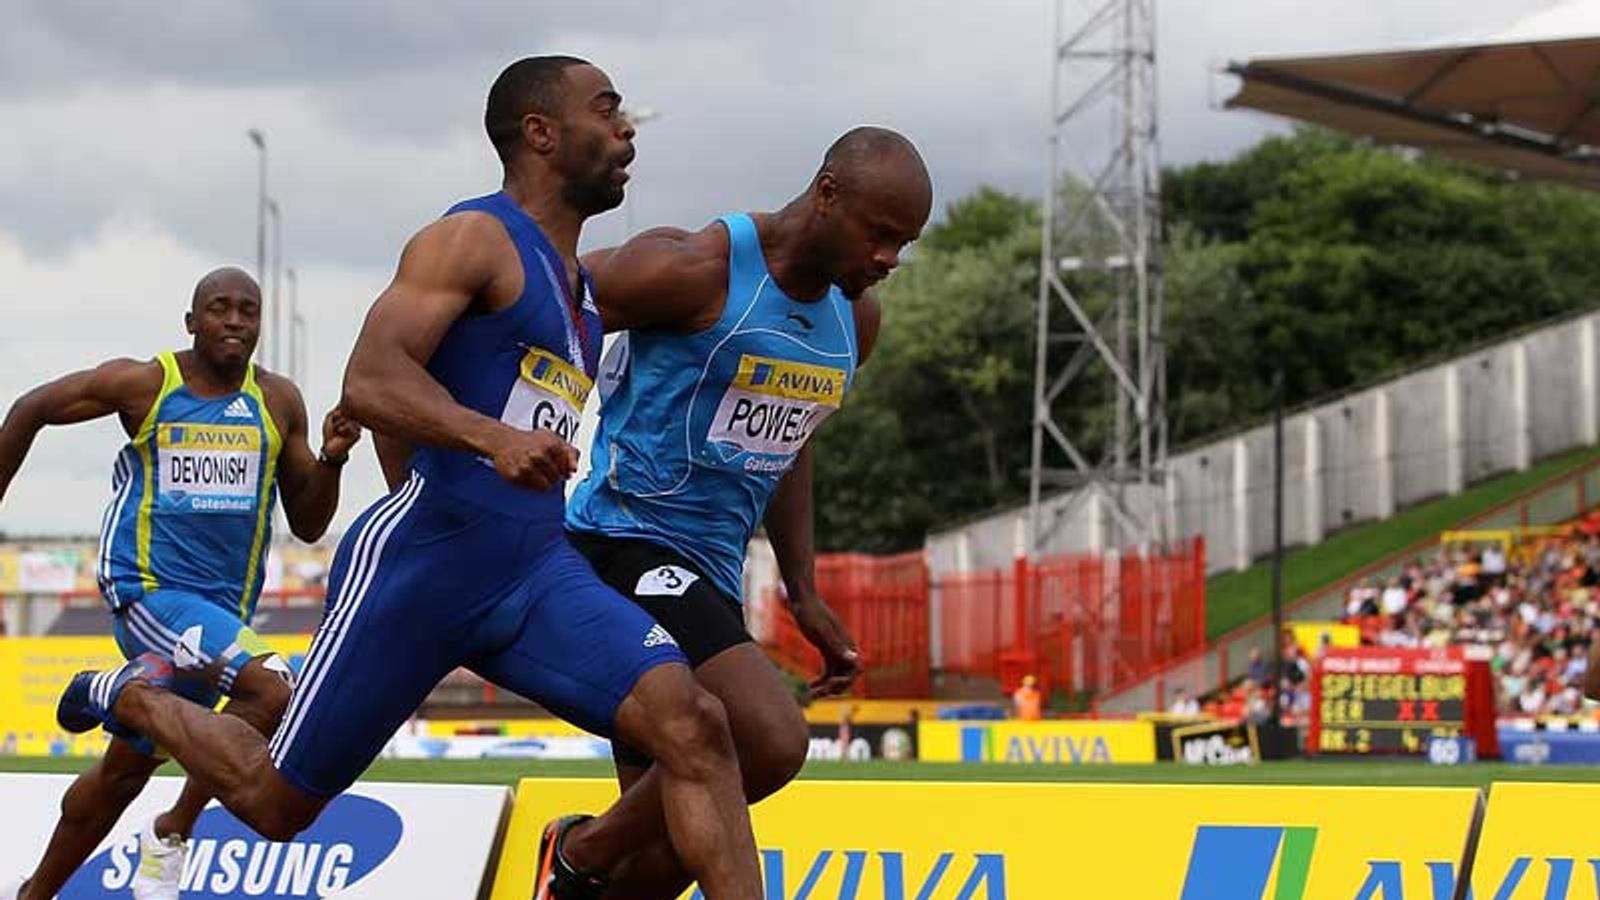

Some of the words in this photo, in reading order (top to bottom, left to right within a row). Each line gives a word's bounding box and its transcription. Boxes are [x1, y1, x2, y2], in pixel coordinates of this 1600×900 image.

[777, 373, 833, 395] AVIVA
[532, 401, 579, 443] GAY
[195, 432, 249, 446] AVIVA
[172, 455, 247, 485] DEVONISH
[658, 567, 682, 589] 3
[1398, 702, 1415, 721] X
[1421, 702, 1440, 721] X
[1003, 735, 1113, 764] AVIVA
[101, 838, 354, 898] SMSUNG
[688, 849, 1008, 900] VIVA
